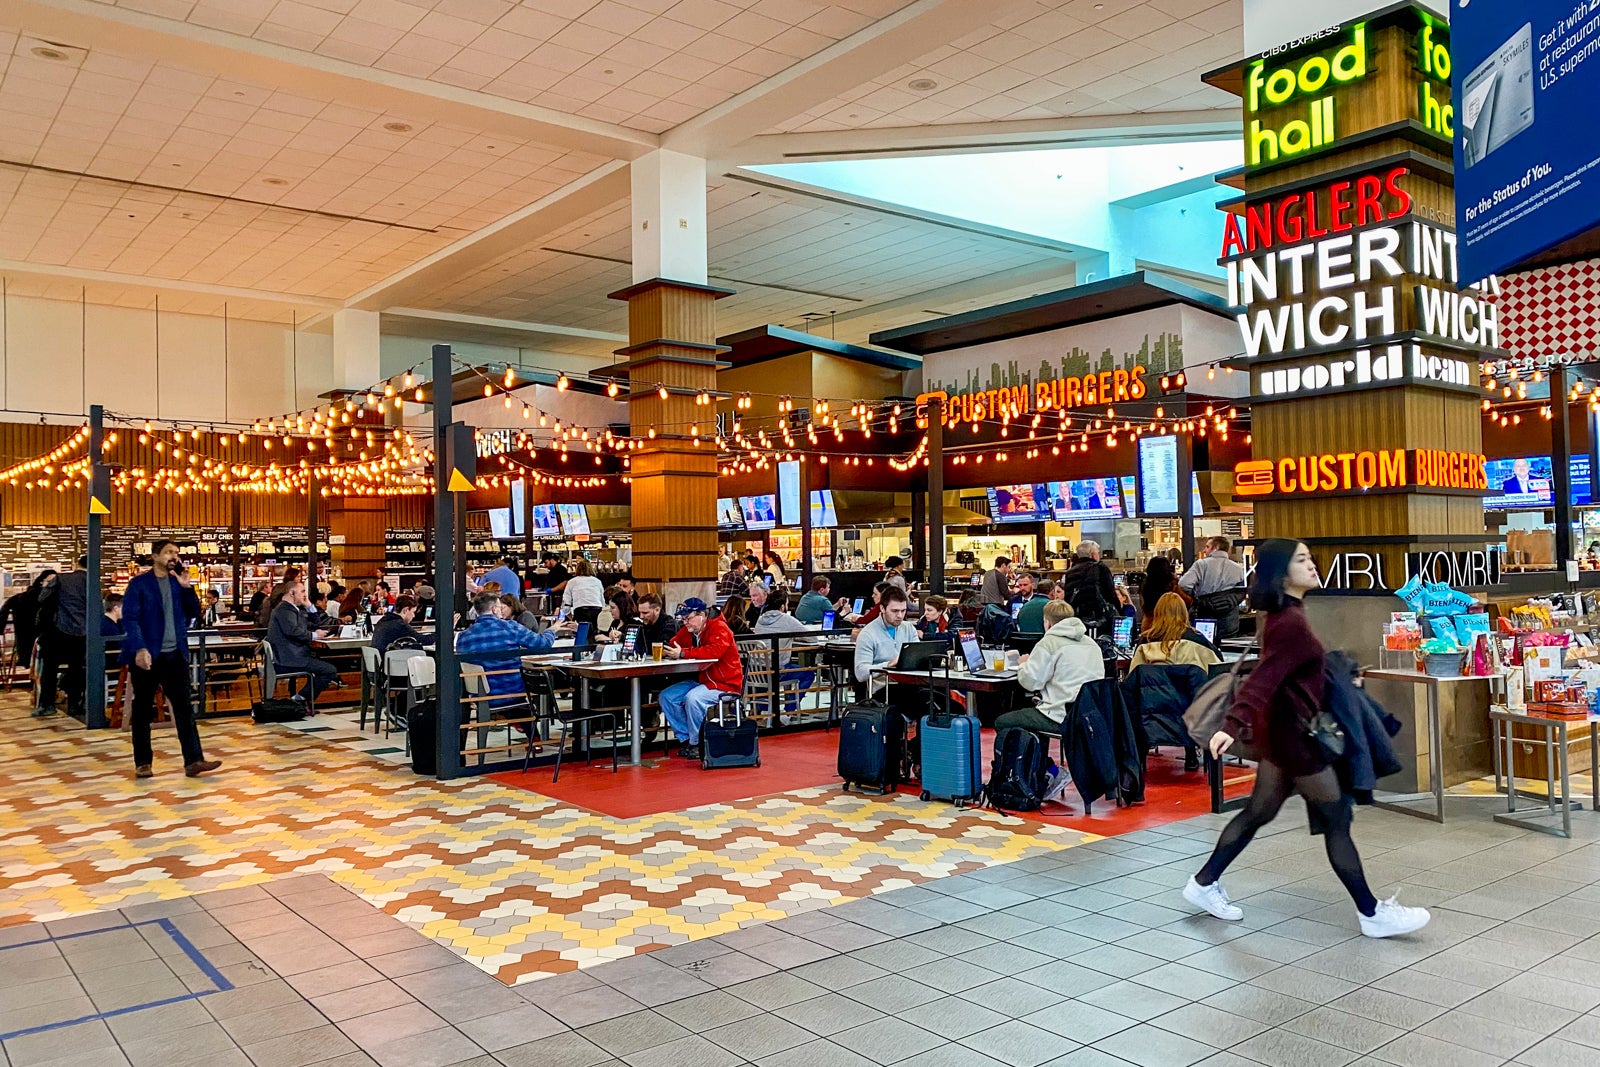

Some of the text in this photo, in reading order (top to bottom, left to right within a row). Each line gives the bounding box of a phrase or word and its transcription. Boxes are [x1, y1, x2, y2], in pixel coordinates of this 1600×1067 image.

[1261, 24, 1341, 59] CIBO EXPRESS
[1423, 25, 1451, 80] fo
[1539, 28, 1556, 52] Get
[1558, 21, 1565, 37] it
[1566, 2, 1588, 29] with
[1540, 14, 1600, 71] at restauran
[1249, 22, 1366, 112] food
[1541, 67, 1558, 91] U.S.
[1250, 96, 1335, 165] hall
[1221, 167, 1412, 260] ANGLERS
[1465, 162, 1552, 222] For the Status of You.
[1227, 226, 1406, 307] INTER
[1237, 286, 1395, 357] WICH
[1419, 284, 1499, 349] WICH
[949, 384, 1029, 424] CUSTOM
[1036, 365, 1147, 413] BURGERS
[1260, 345, 1470, 395] world bean
[1278, 449, 1407, 494] CUSTOM
[1415, 448, 1488, 490] BURGERS
[1243, 552, 1409, 590] KMBU
[1419, 550, 1502, 586] KOMBU
